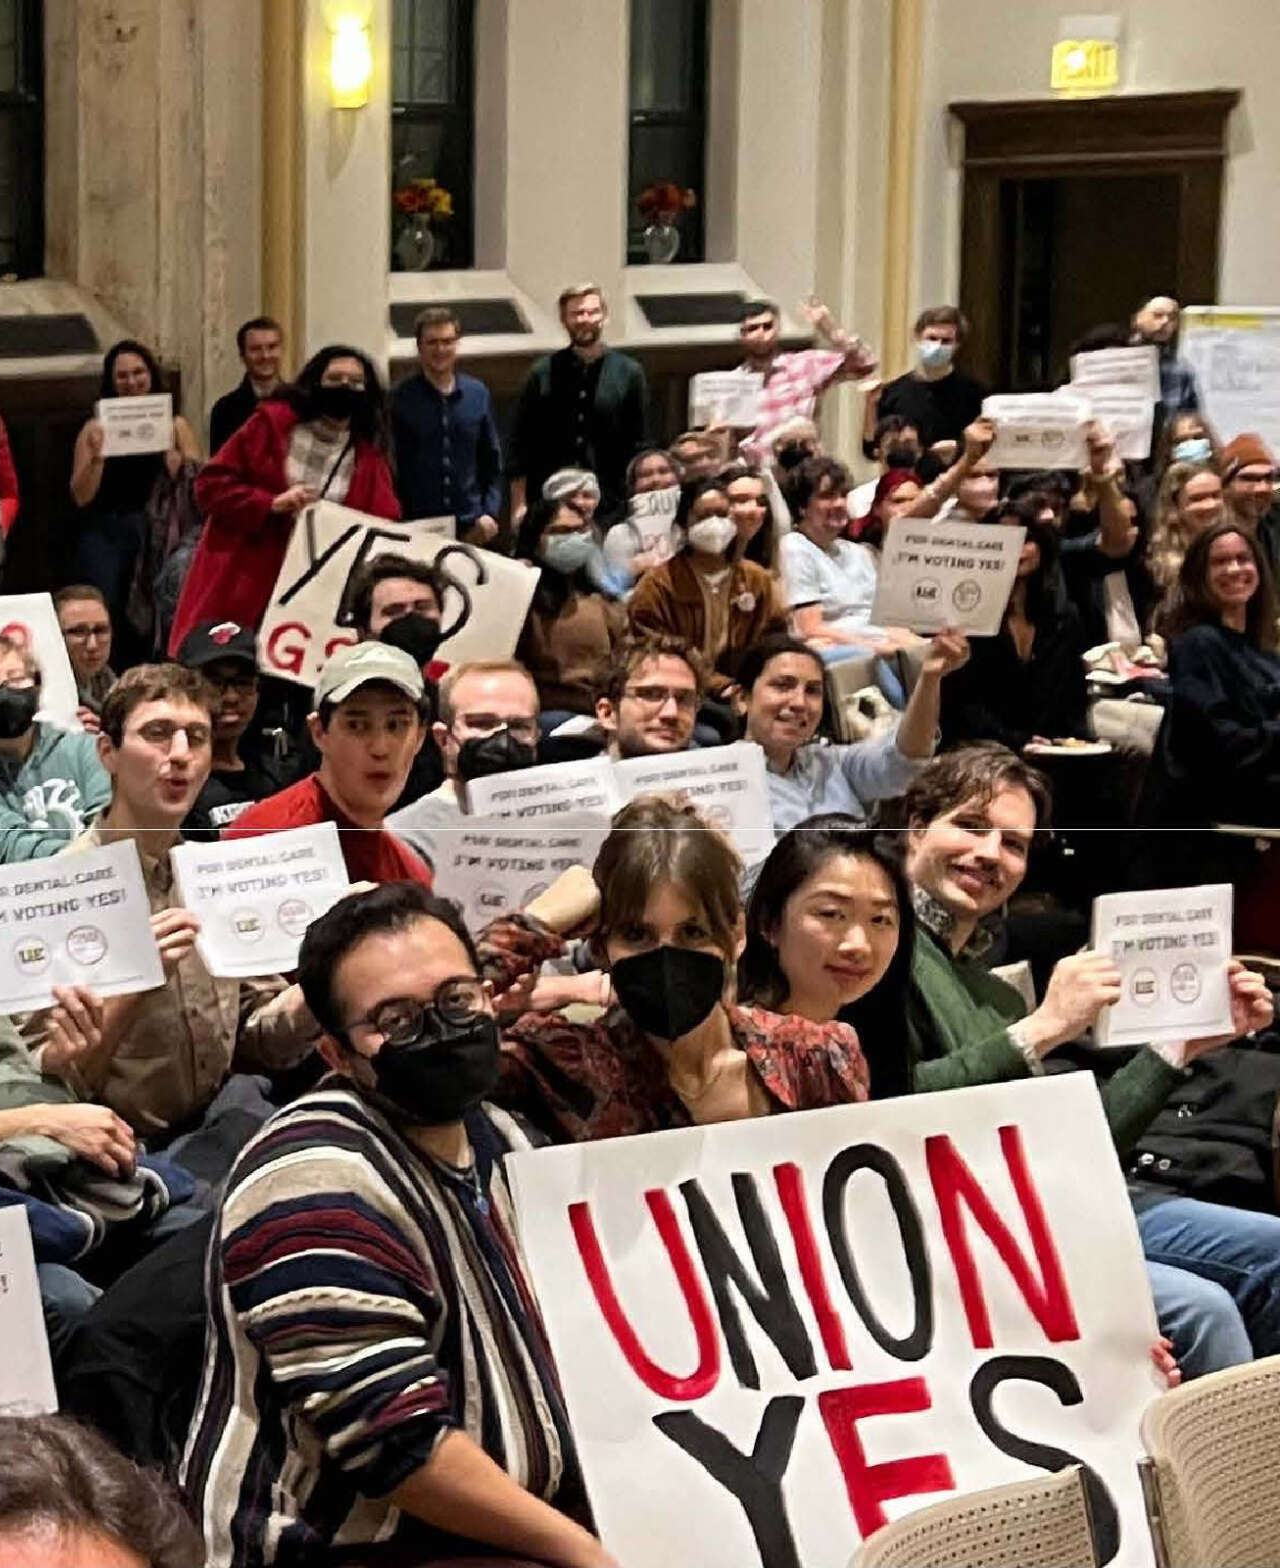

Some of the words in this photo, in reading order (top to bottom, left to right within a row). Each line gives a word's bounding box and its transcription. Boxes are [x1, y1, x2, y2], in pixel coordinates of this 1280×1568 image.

[924, 555, 975, 569] VOTING
[227, 873, 288, 893] VOTING
[13, 898, 80, 922] VOTING
[87, 887, 127, 908] YES!
[567, 1124, 1081, 1402] UNION
[653, 1355, 1121, 1568] YES
